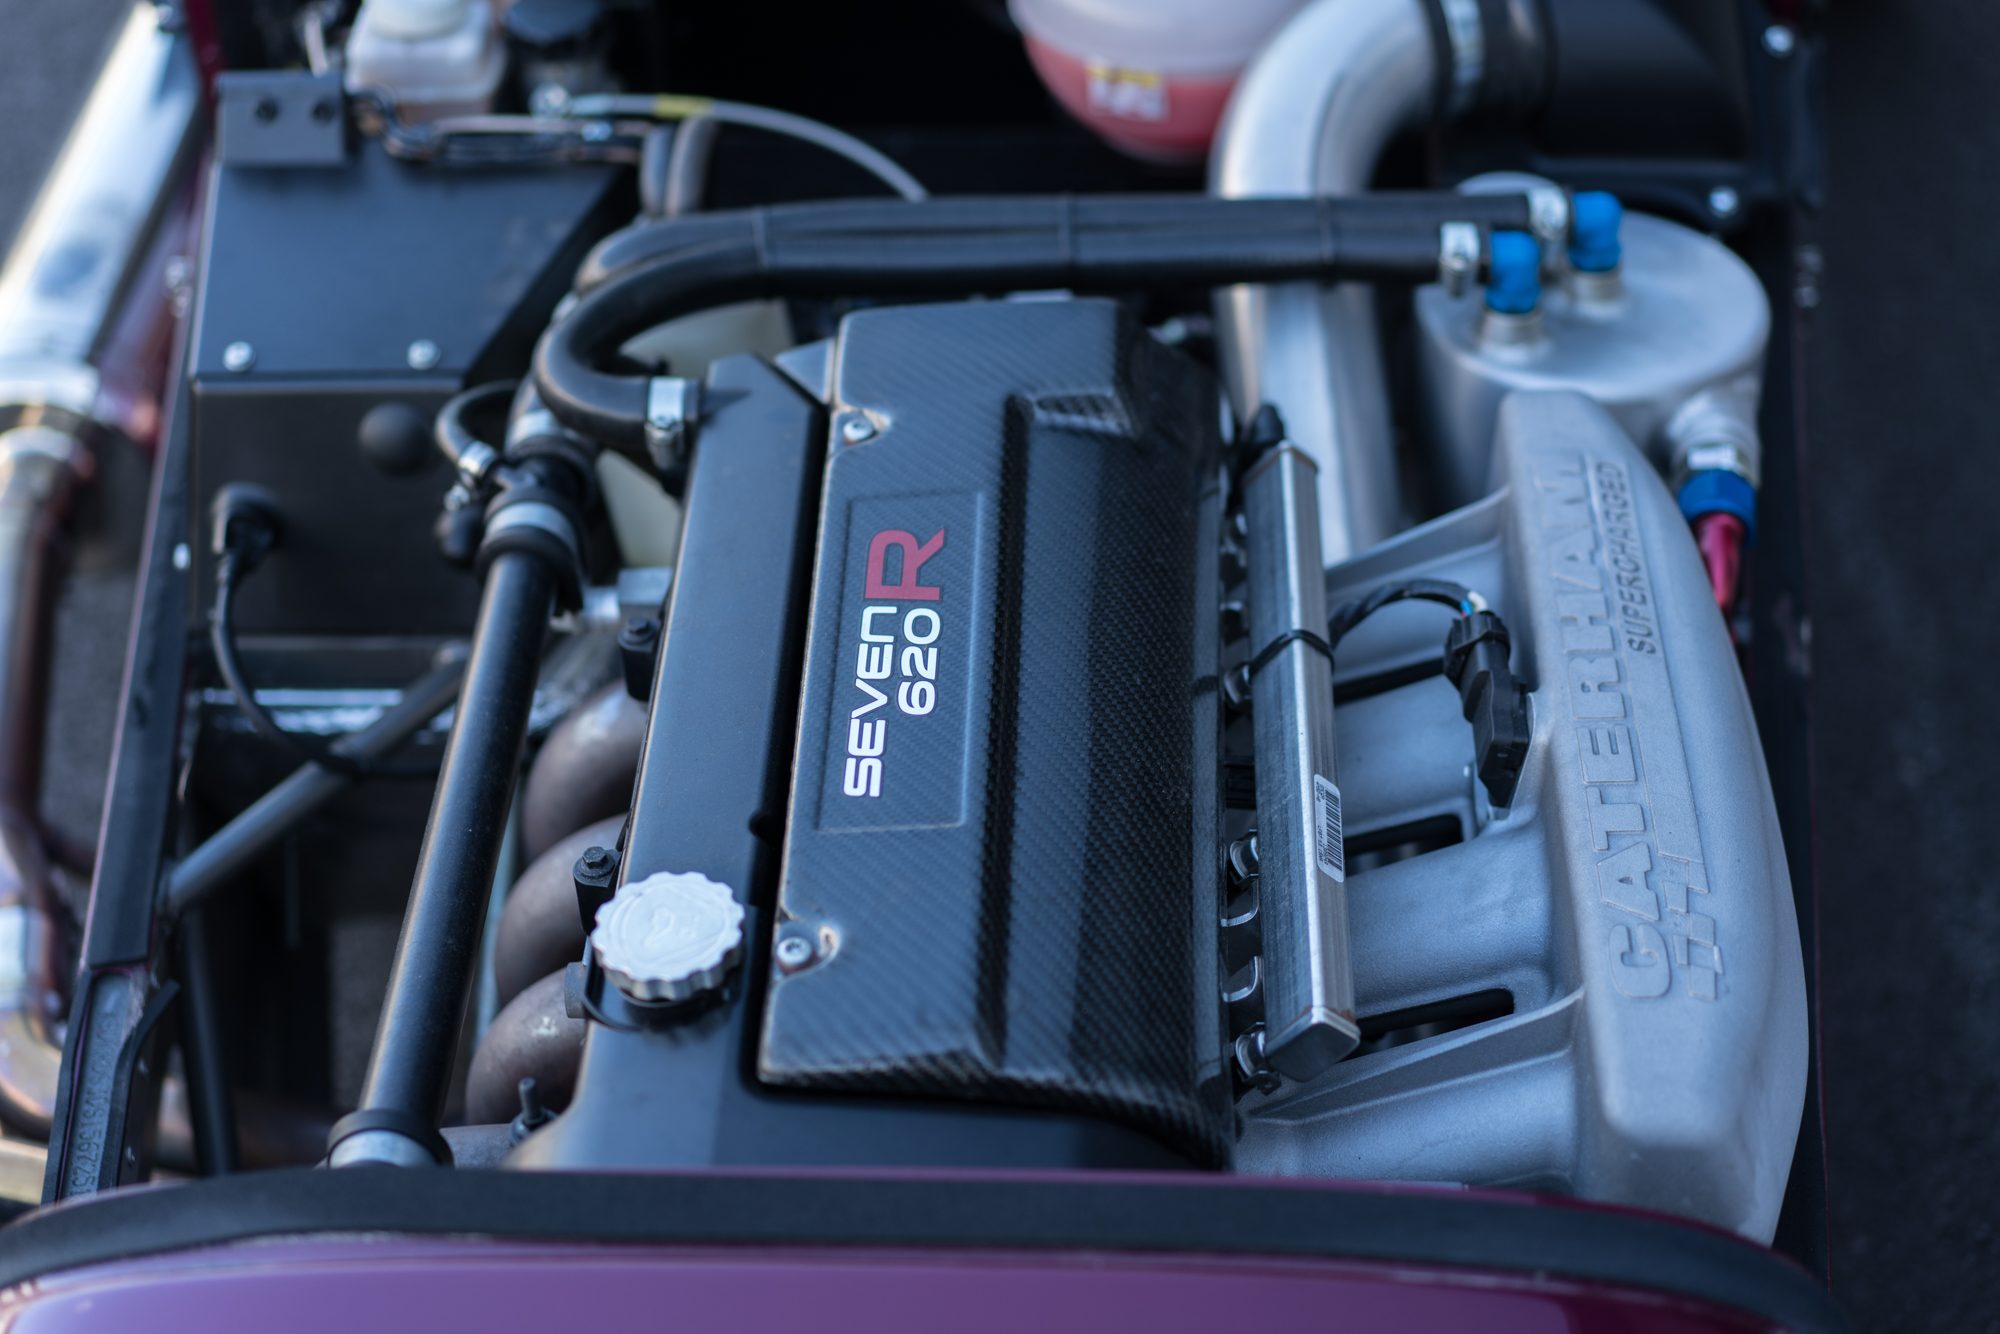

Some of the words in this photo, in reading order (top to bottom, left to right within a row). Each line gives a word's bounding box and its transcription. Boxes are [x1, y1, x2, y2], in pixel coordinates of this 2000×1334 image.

[1595, 461, 1657, 655] SUPERCHARGED
[842, 605, 898, 799] SEVEN
[1533, 453, 1671, 998] CATERHAM
